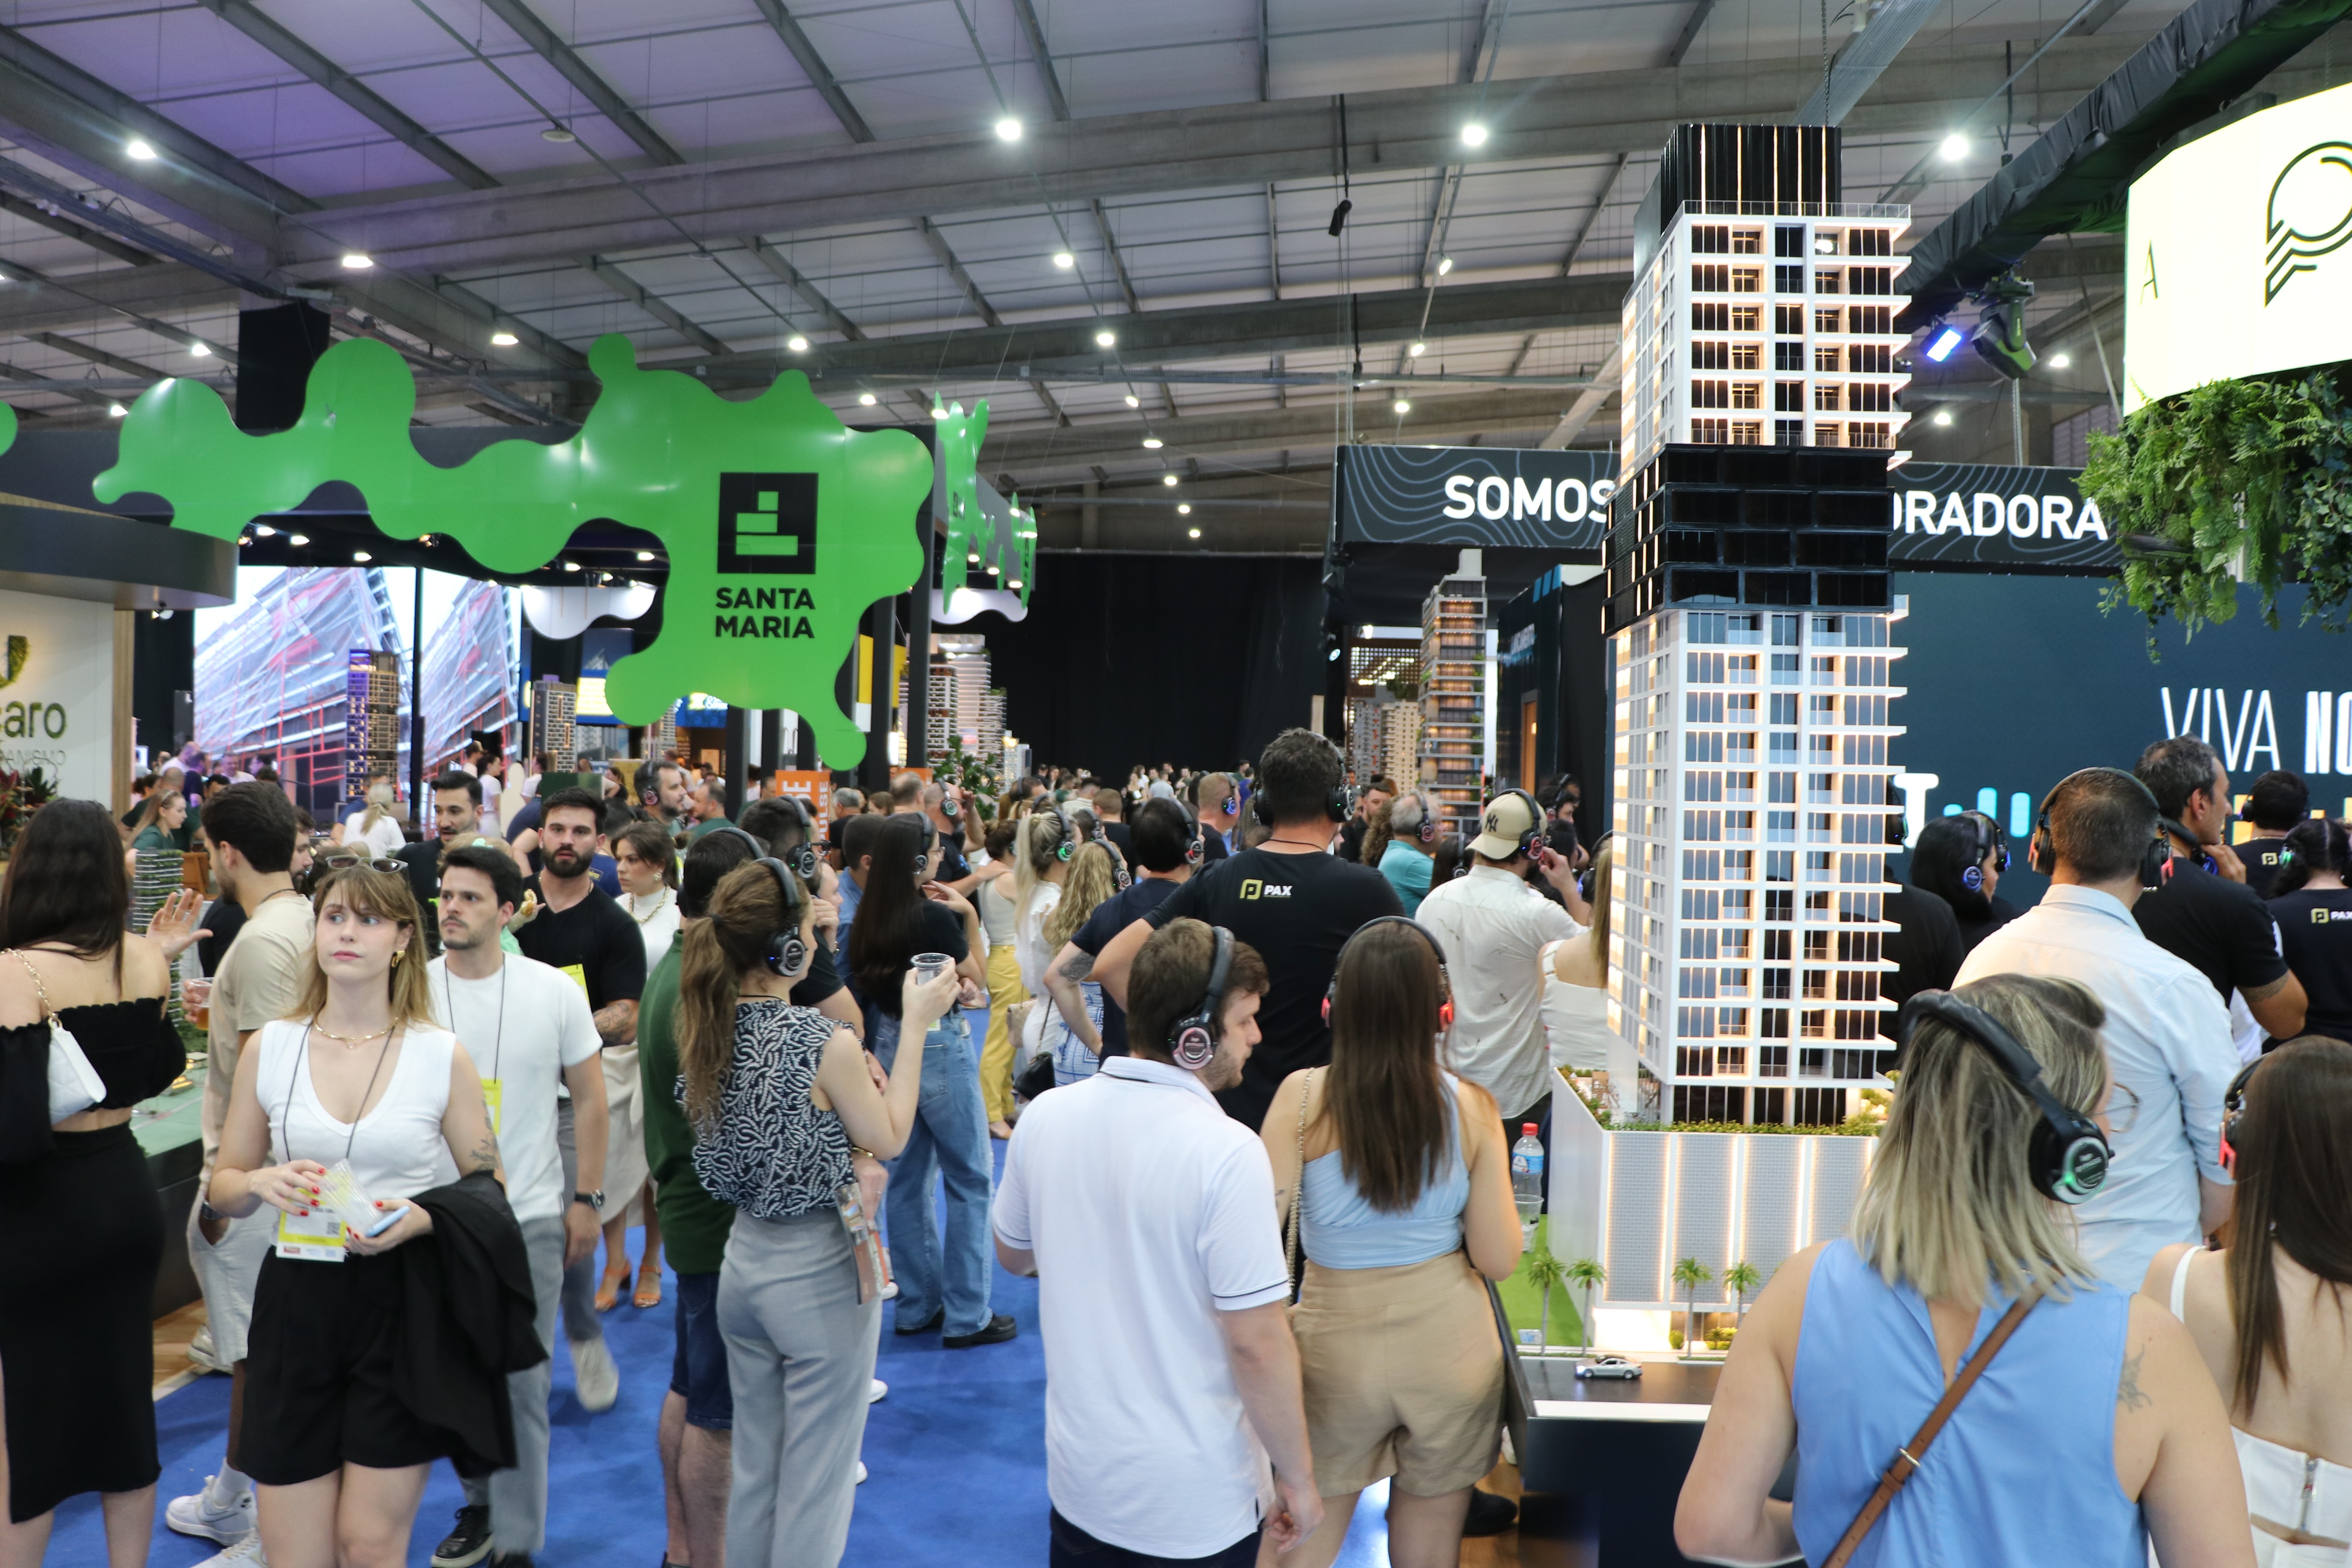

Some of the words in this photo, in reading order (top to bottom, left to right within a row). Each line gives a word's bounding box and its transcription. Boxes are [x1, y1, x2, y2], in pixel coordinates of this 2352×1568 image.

[1443, 475, 1615, 523] SOMOS
[1893, 490, 2108, 541] RADORA
[716, 587, 816, 609] SANTA
[715, 615, 815, 638] MARIA
[0, 701, 67, 739] aro
[2161, 687, 2281, 772] VIVA
[1264, 885, 1293, 896] PAX
[2330, 911, 2352, 920] PAX
